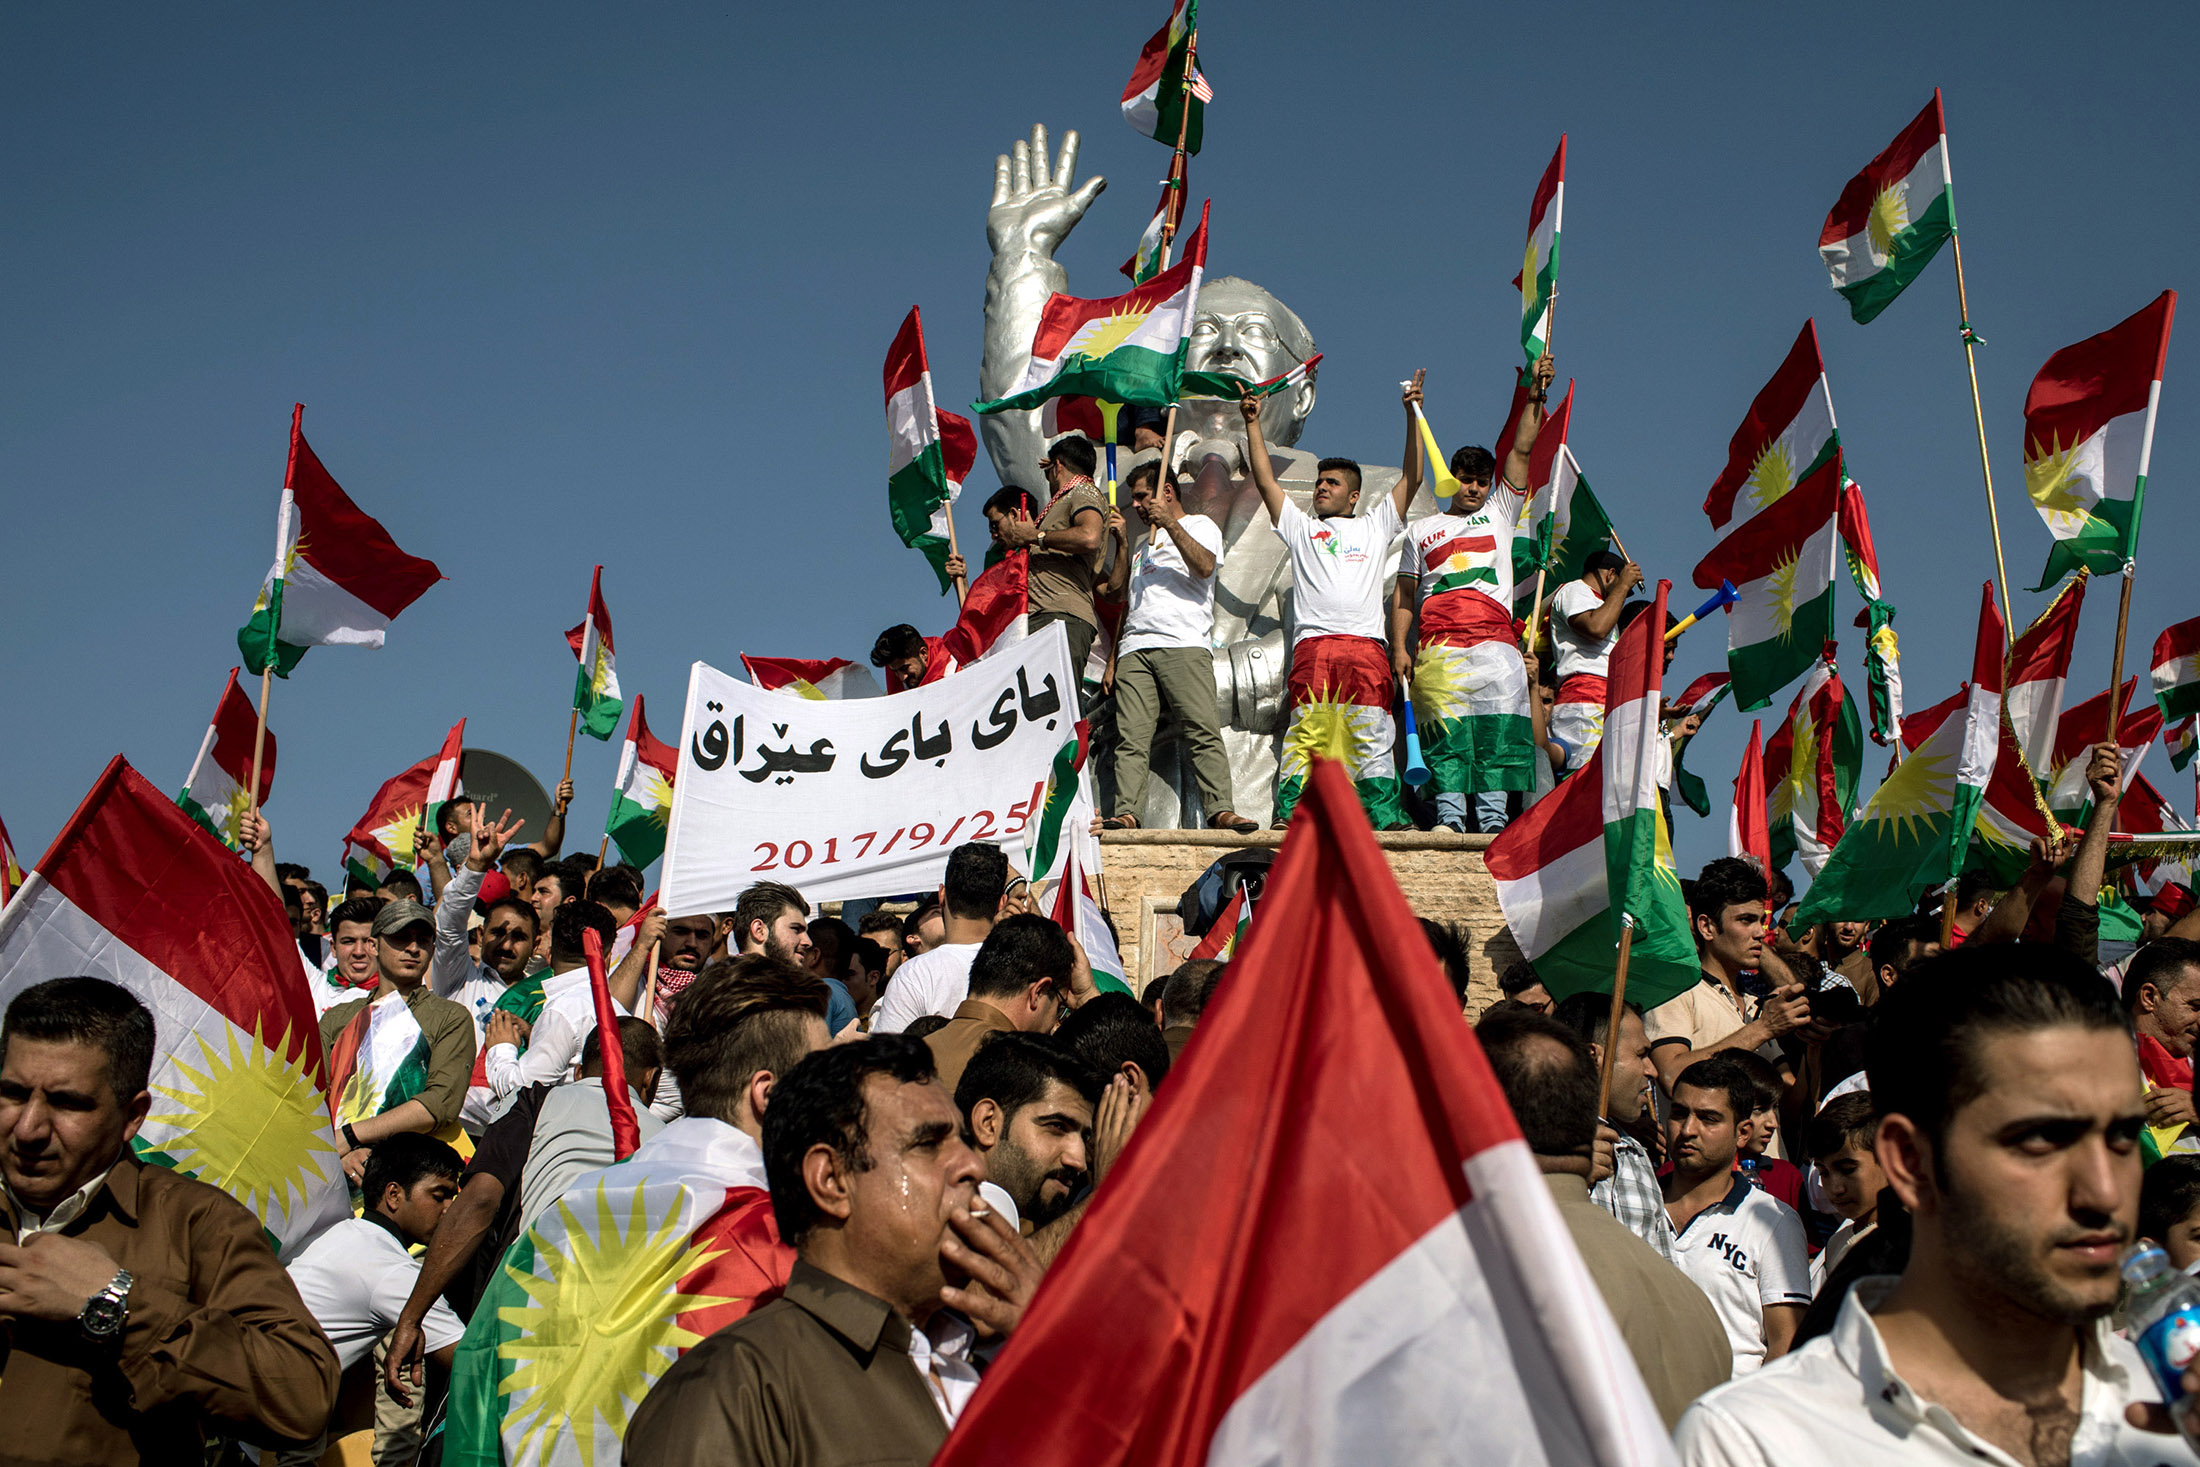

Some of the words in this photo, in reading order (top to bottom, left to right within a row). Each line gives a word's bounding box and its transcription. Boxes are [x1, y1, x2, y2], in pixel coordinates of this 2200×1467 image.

[691, 700, 837, 786] عێراق
[860, 710, 953, 780] بای
[971, 664, 1061, 751] بای
[1707, 1232, 1747, 1271] NYC
